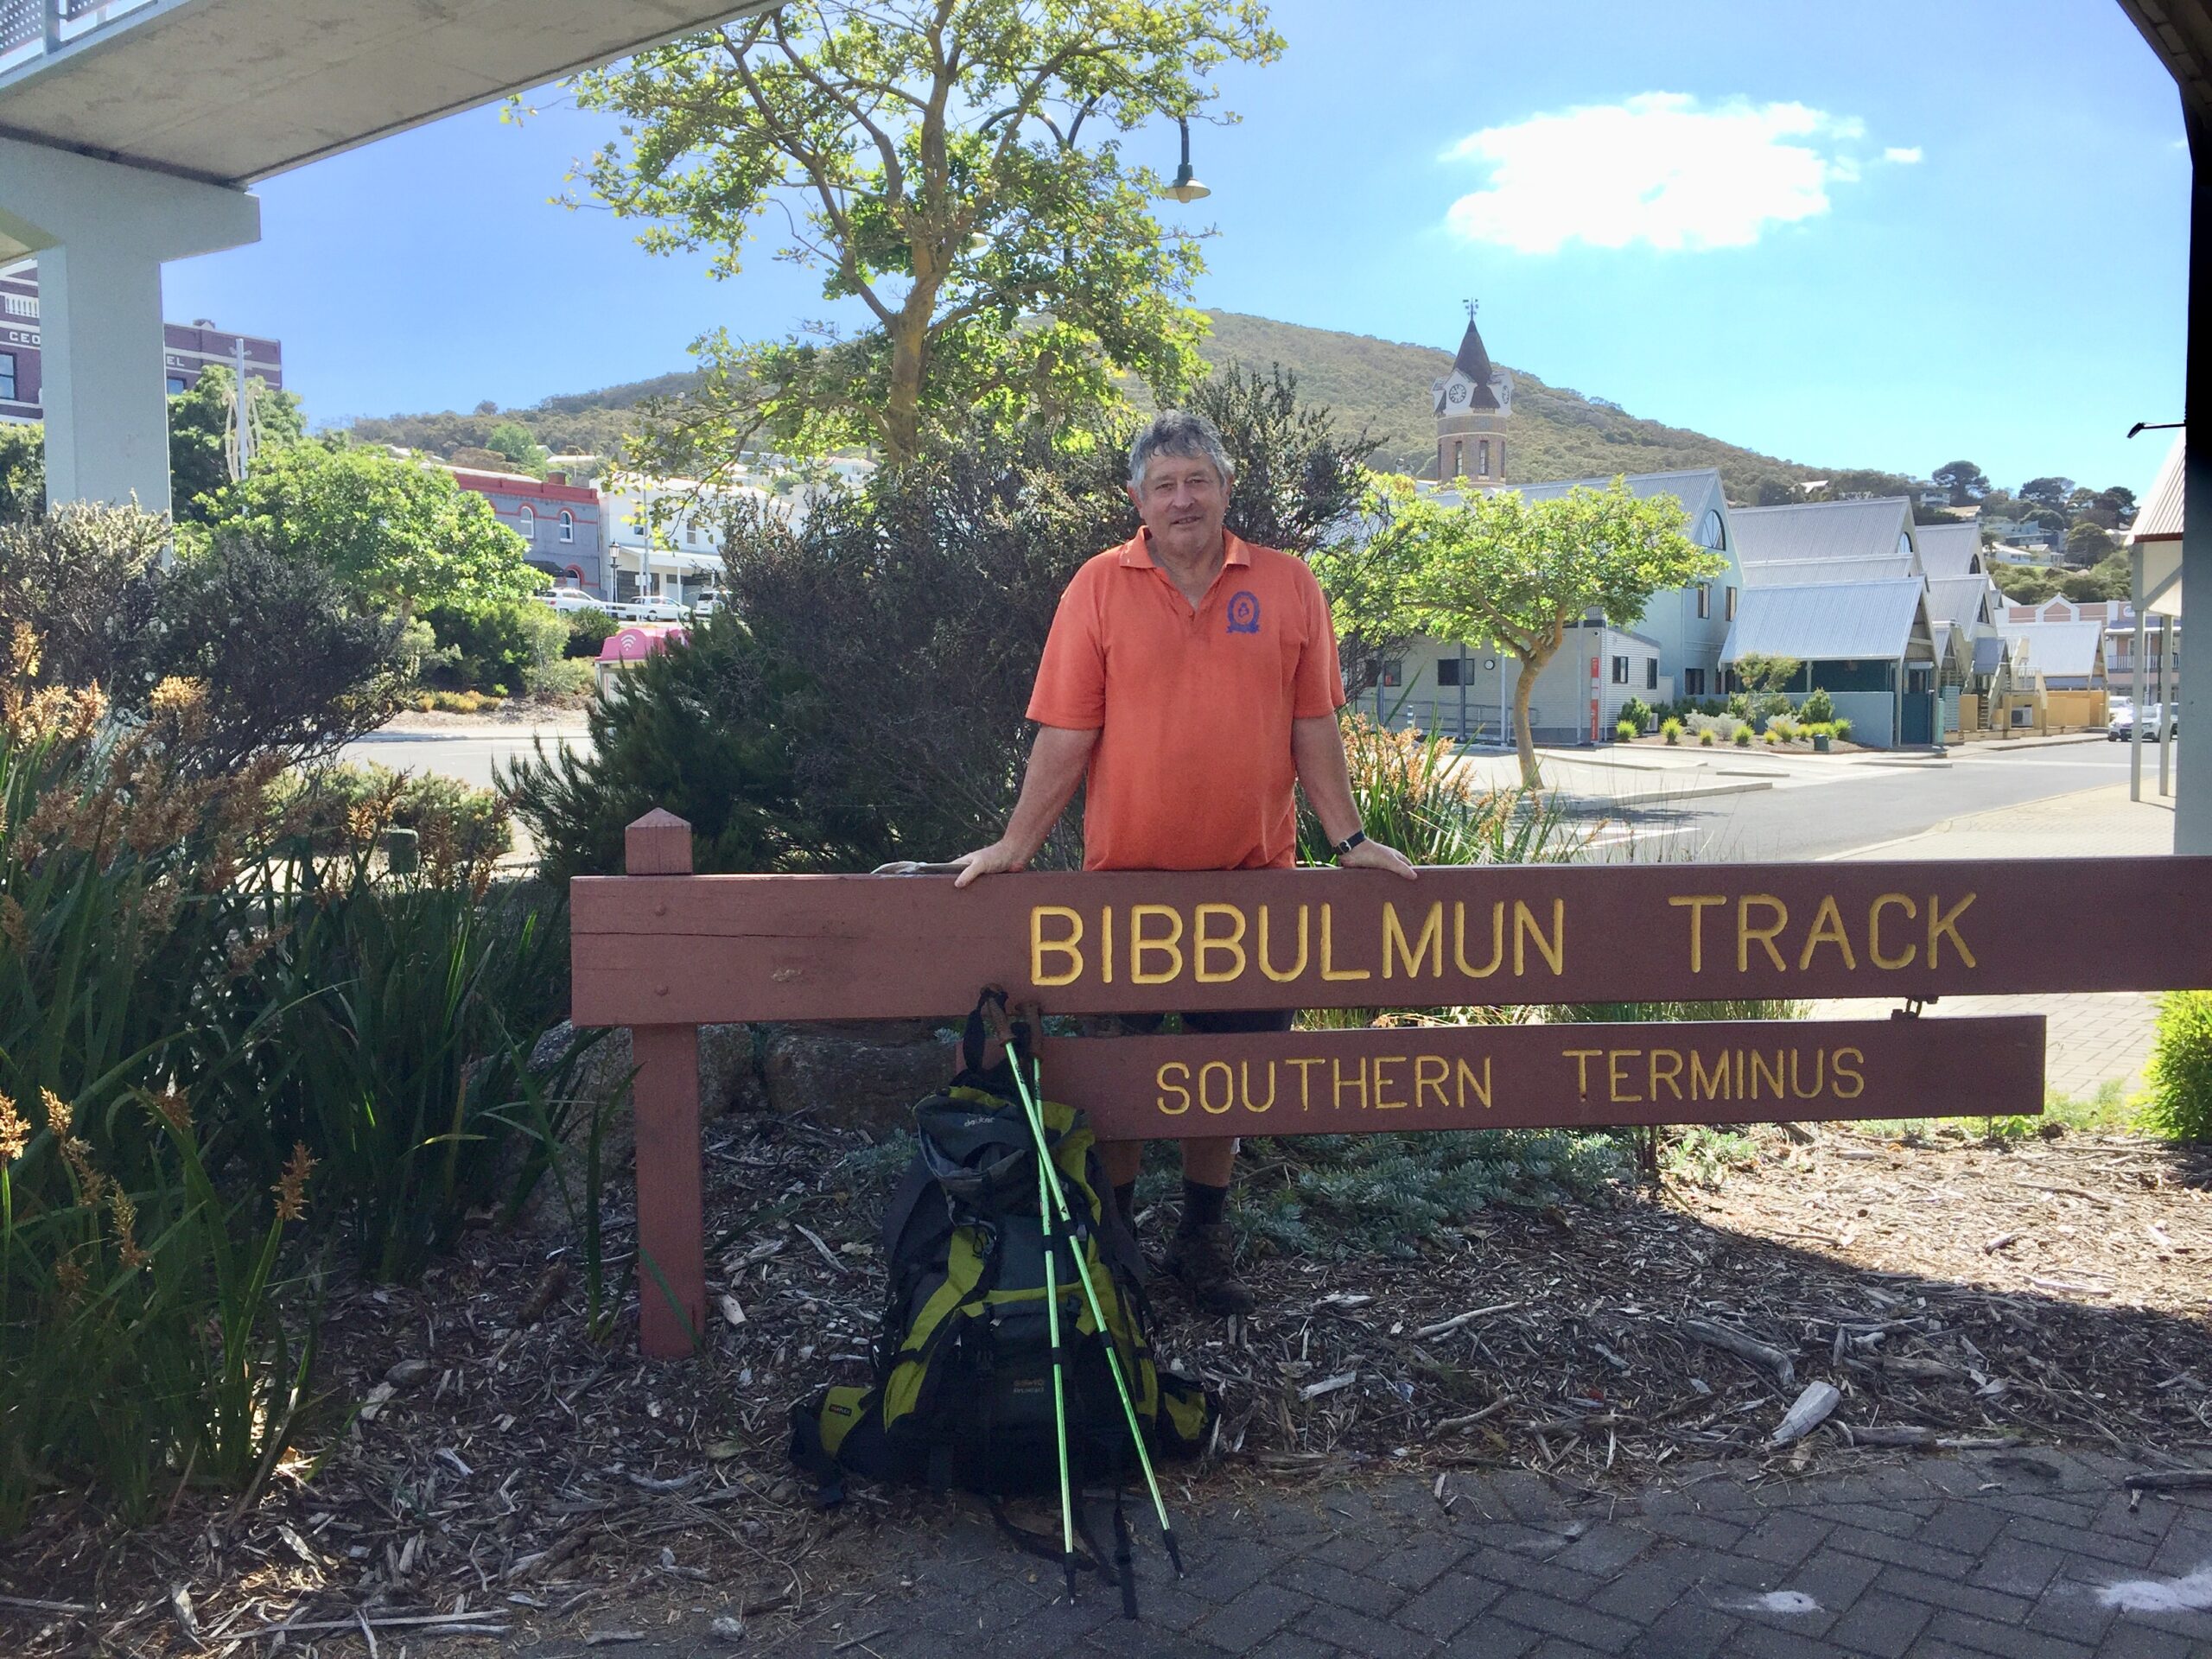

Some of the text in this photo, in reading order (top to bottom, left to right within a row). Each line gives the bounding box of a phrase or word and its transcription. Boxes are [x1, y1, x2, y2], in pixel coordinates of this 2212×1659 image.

[1030, 893, 1977, 985] BIBBULMUN TRACK
[1157, 1048, 1866, 1116] SOUTHERN TERMINUS
